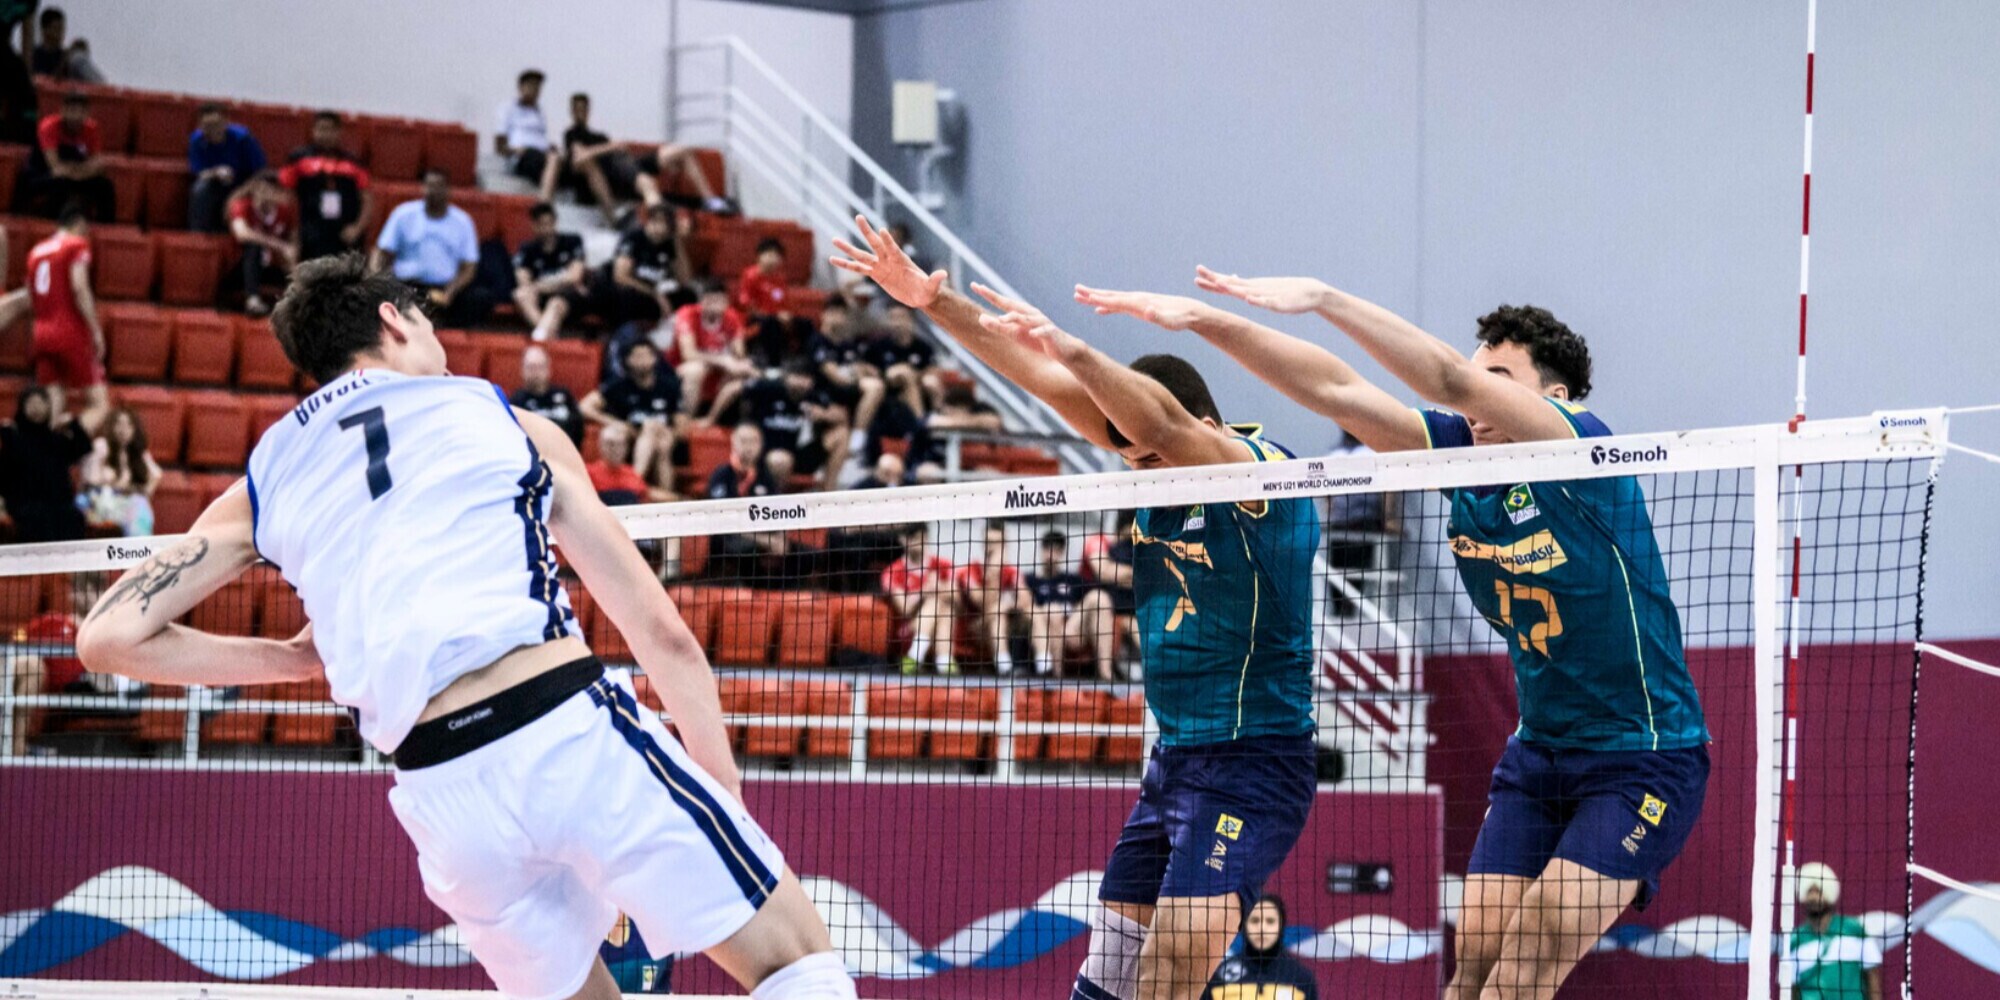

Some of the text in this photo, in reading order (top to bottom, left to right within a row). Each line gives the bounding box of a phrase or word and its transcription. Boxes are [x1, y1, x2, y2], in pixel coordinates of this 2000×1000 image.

[1890, 416, 1927, 427] Senoh
[337, 405, 393, 501] 7
[1608, 445, 1668, 464] Senoh
[1308, 462, 1325, 471] FIVB
[1263, 482, 1282, 492] MEN'S
[1284, 481, 1296, 490] U21
[1297, 479, 1322, 489] WORLD
[1323, 476, 1373, 488] CHAMPIONSHIP
[1005, 484, 1067, 509] MIKASA
[762, 504, 806, 520] Senoh
[117, 546, 151, 559] Senoh
